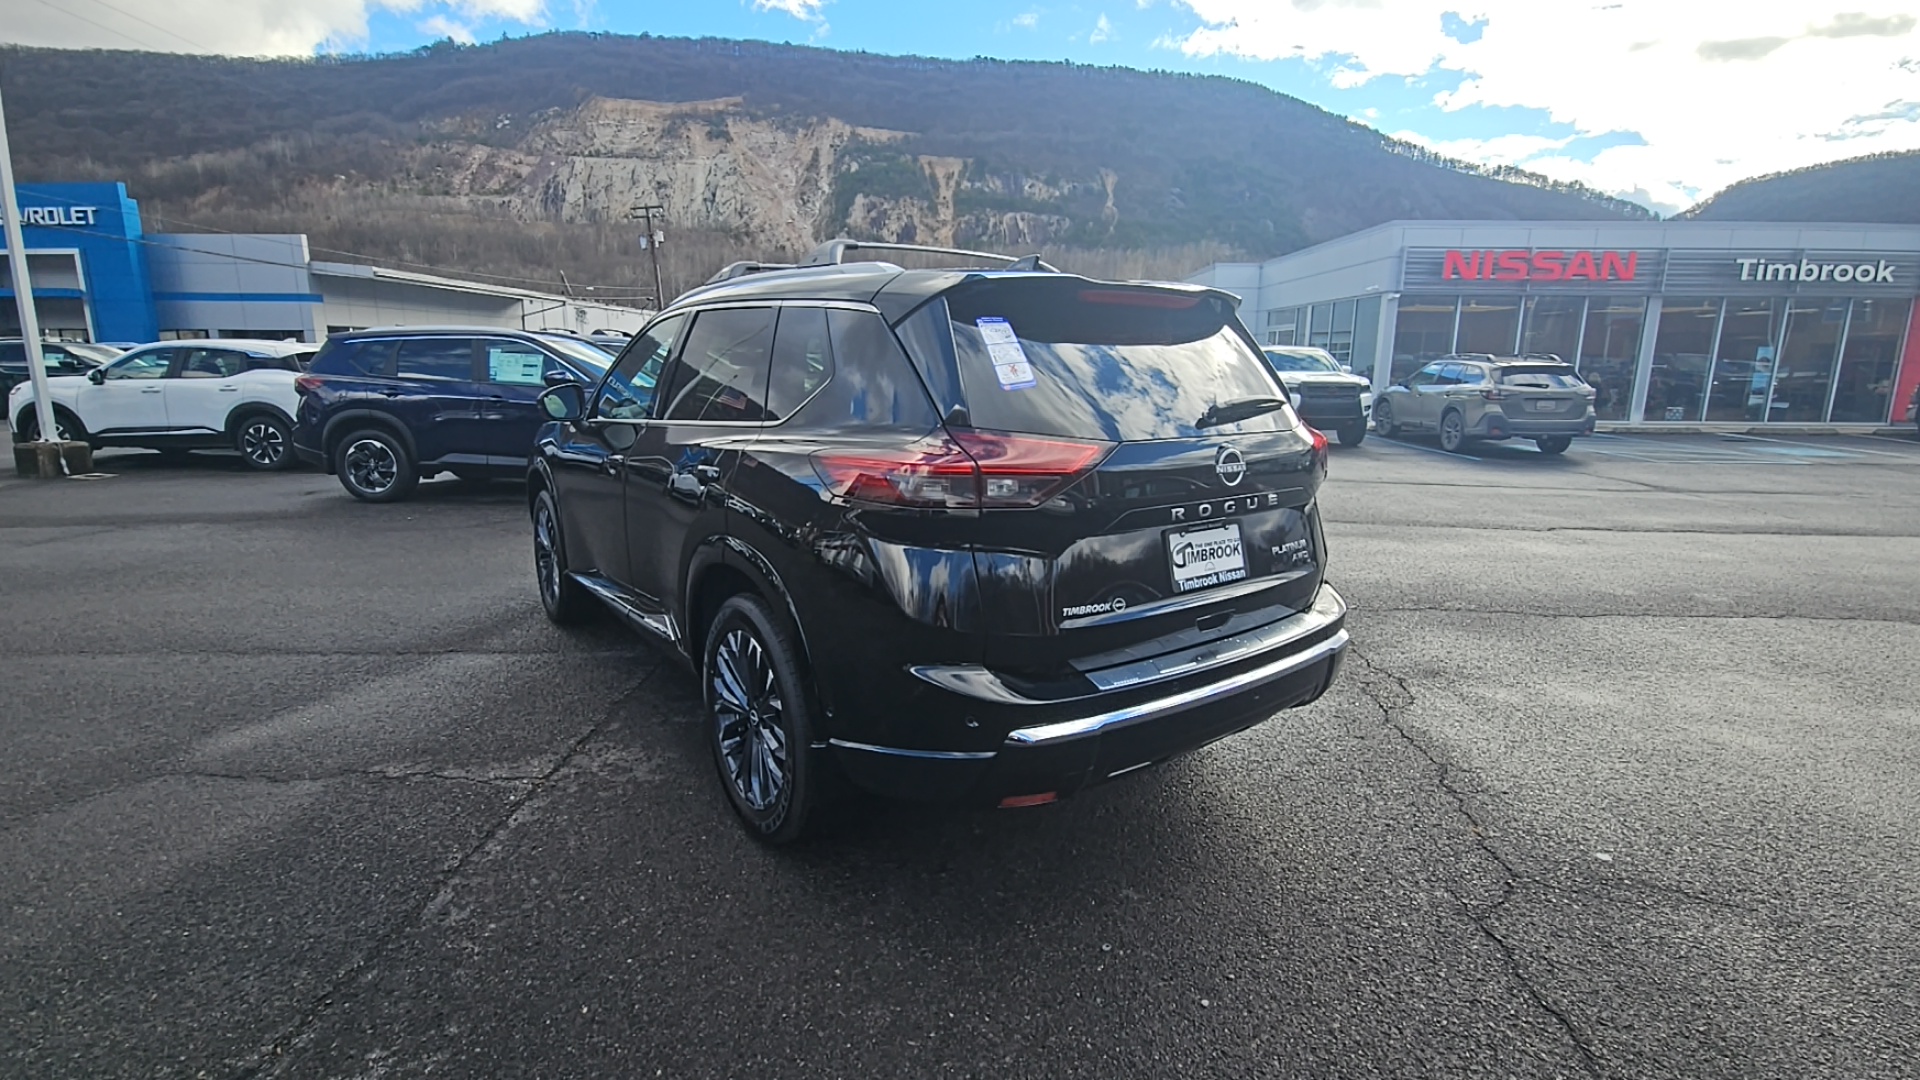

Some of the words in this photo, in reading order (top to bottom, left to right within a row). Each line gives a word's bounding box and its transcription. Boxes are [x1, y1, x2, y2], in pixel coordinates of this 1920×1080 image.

[1442, 250, 1637, 281] NISSAN
[1735, 258, 1896, 283] Timbrook
[1216, 462, 1246, 473] NISSAN
[1171, 493, 1278, 521] ROGUE
[1271, 538, 1307, 556] PLATINUM
[1178, 573, 1219, 592] Timbrook
[1218, 569, 1246, 583] Nissan
[1062, 601, 1112, 617] TIMBROOK
